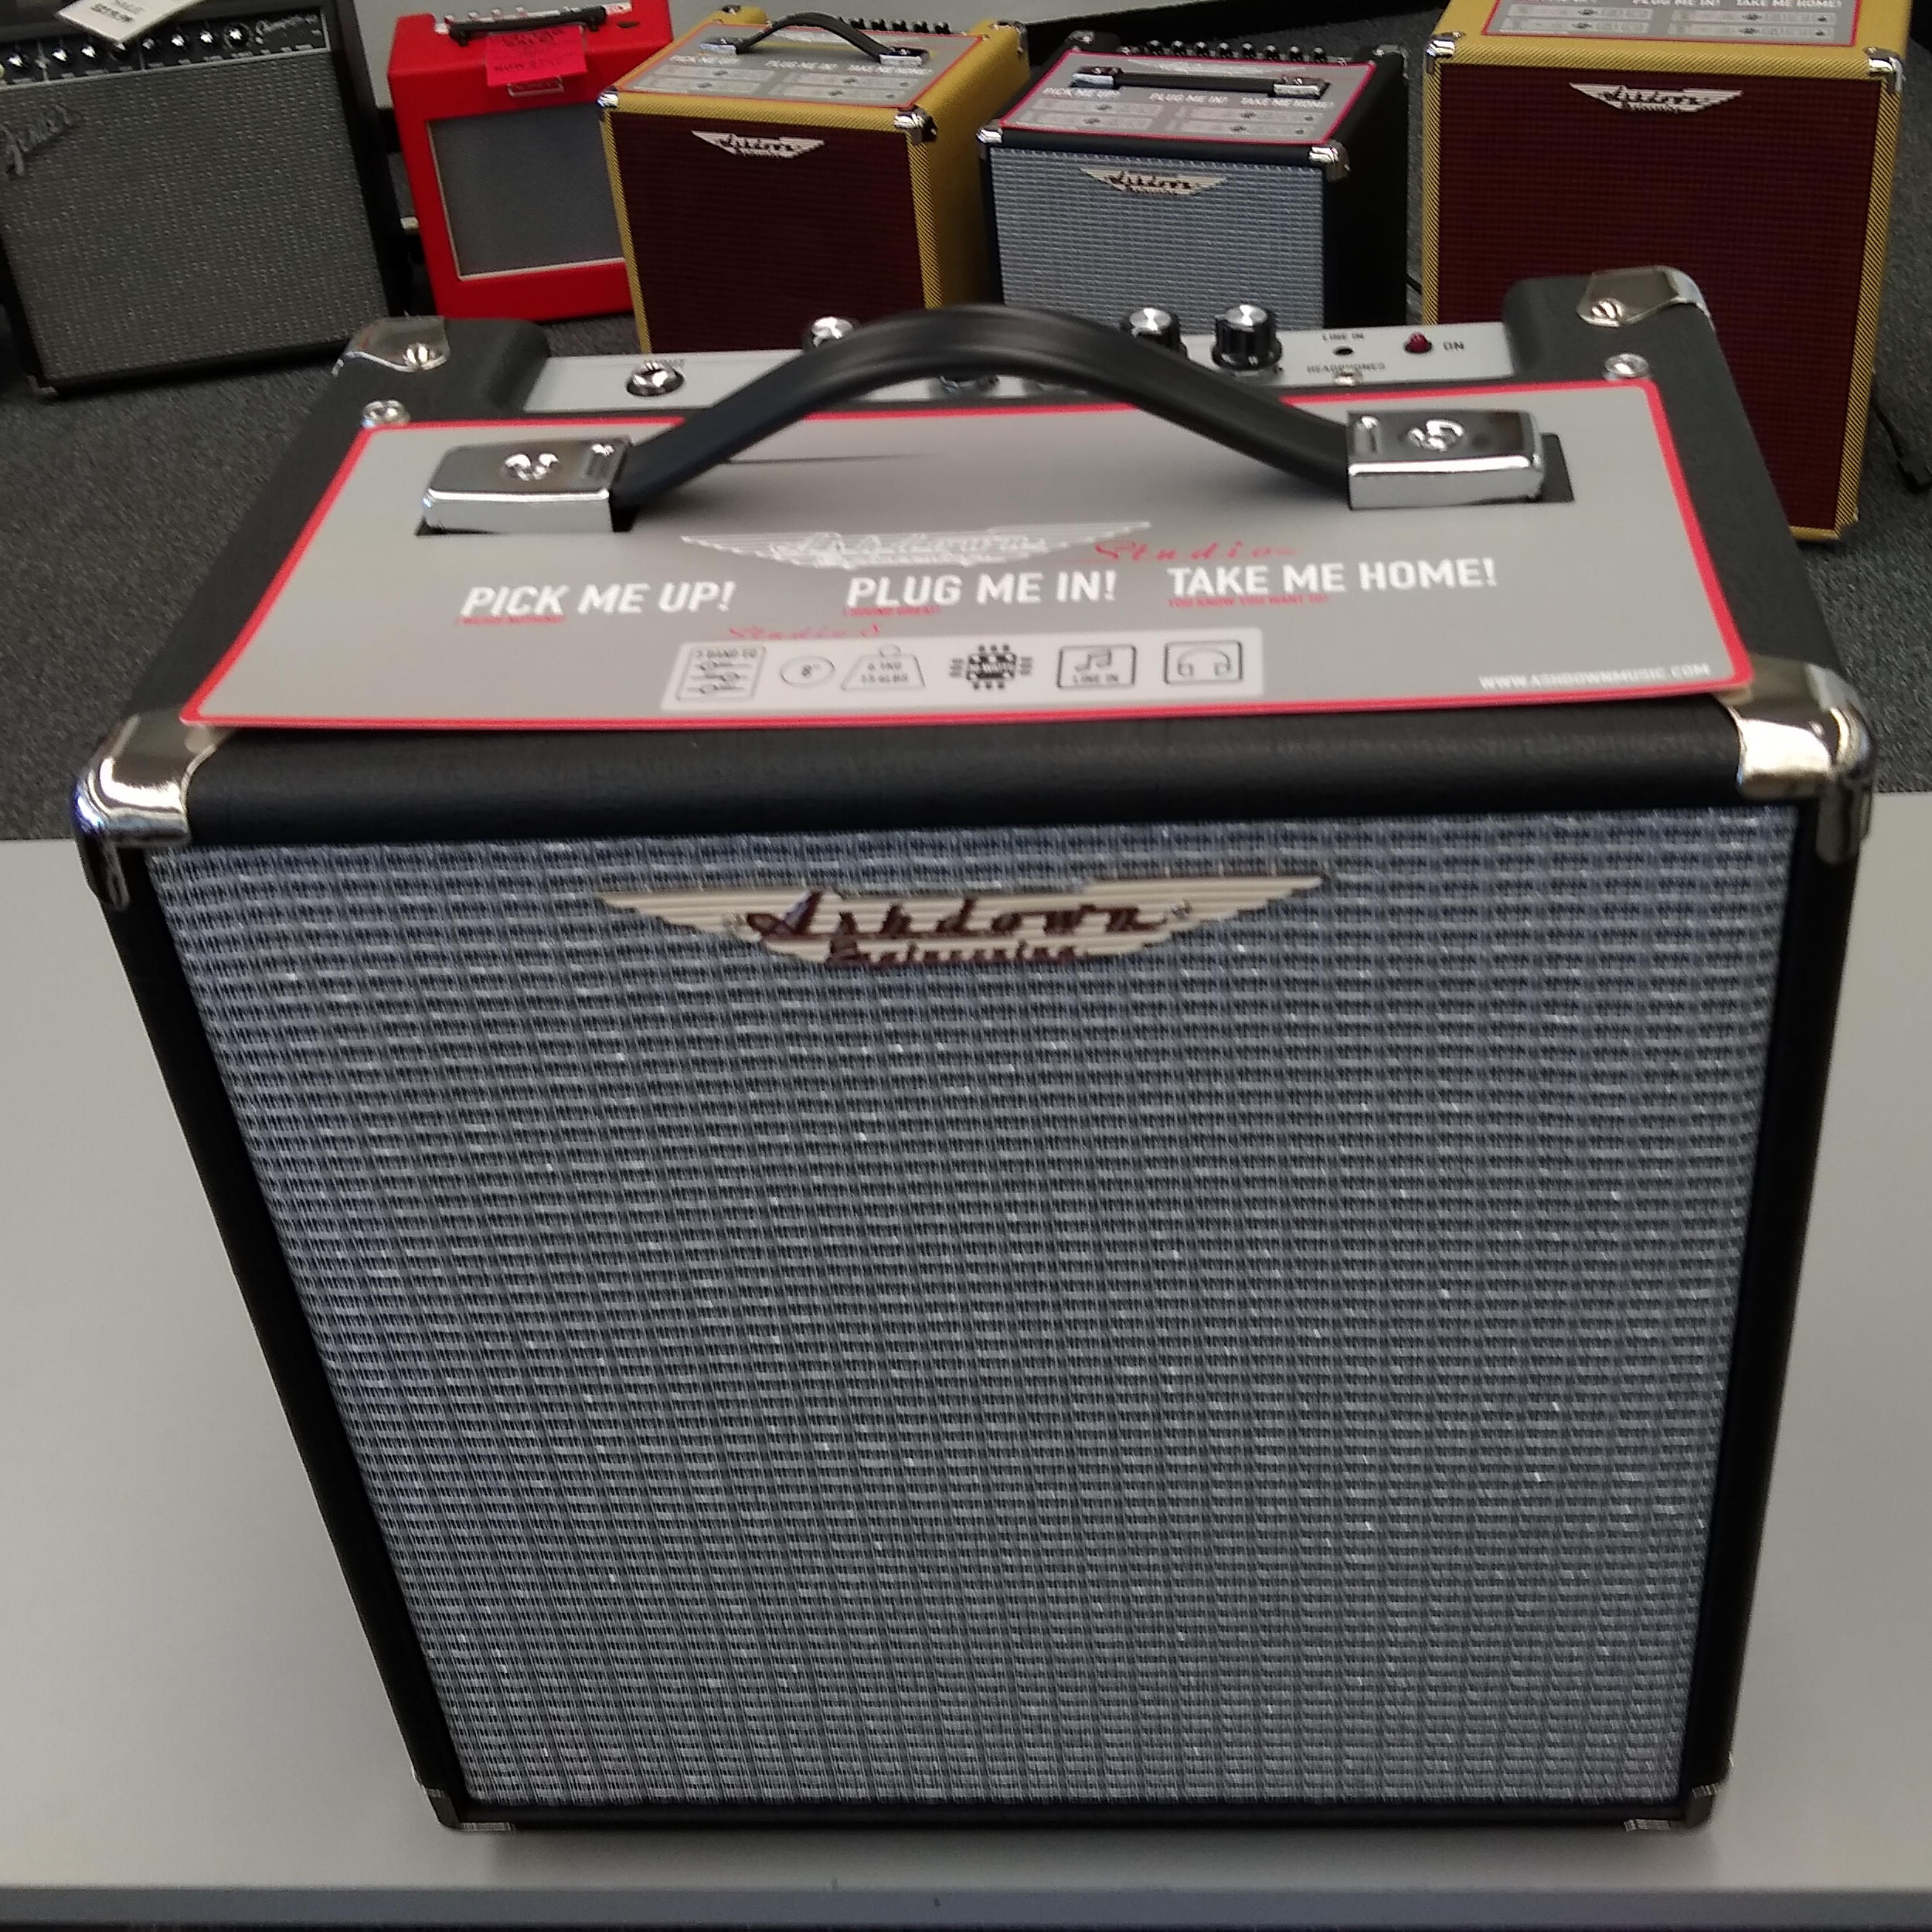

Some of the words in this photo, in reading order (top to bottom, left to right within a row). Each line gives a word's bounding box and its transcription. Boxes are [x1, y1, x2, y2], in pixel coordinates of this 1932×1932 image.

[1443, 340, 1464, 351] ON
[846, 574, 963, 608] PLUG
[975, 570, 1043, 605] ME
[1056, 569, 1117, 604] IN!
[1166, 565, 1270, 597] TAKE
[1282, 562, 1347, 594] ME
[1358, 556, 1498, 592] HOME!
[461, 584, 570, 617] PICK
[578, 583, 651, 615] ME
[658, 580, 736, 613] UP!
[746, 890, 1165, 939] Ashdown
